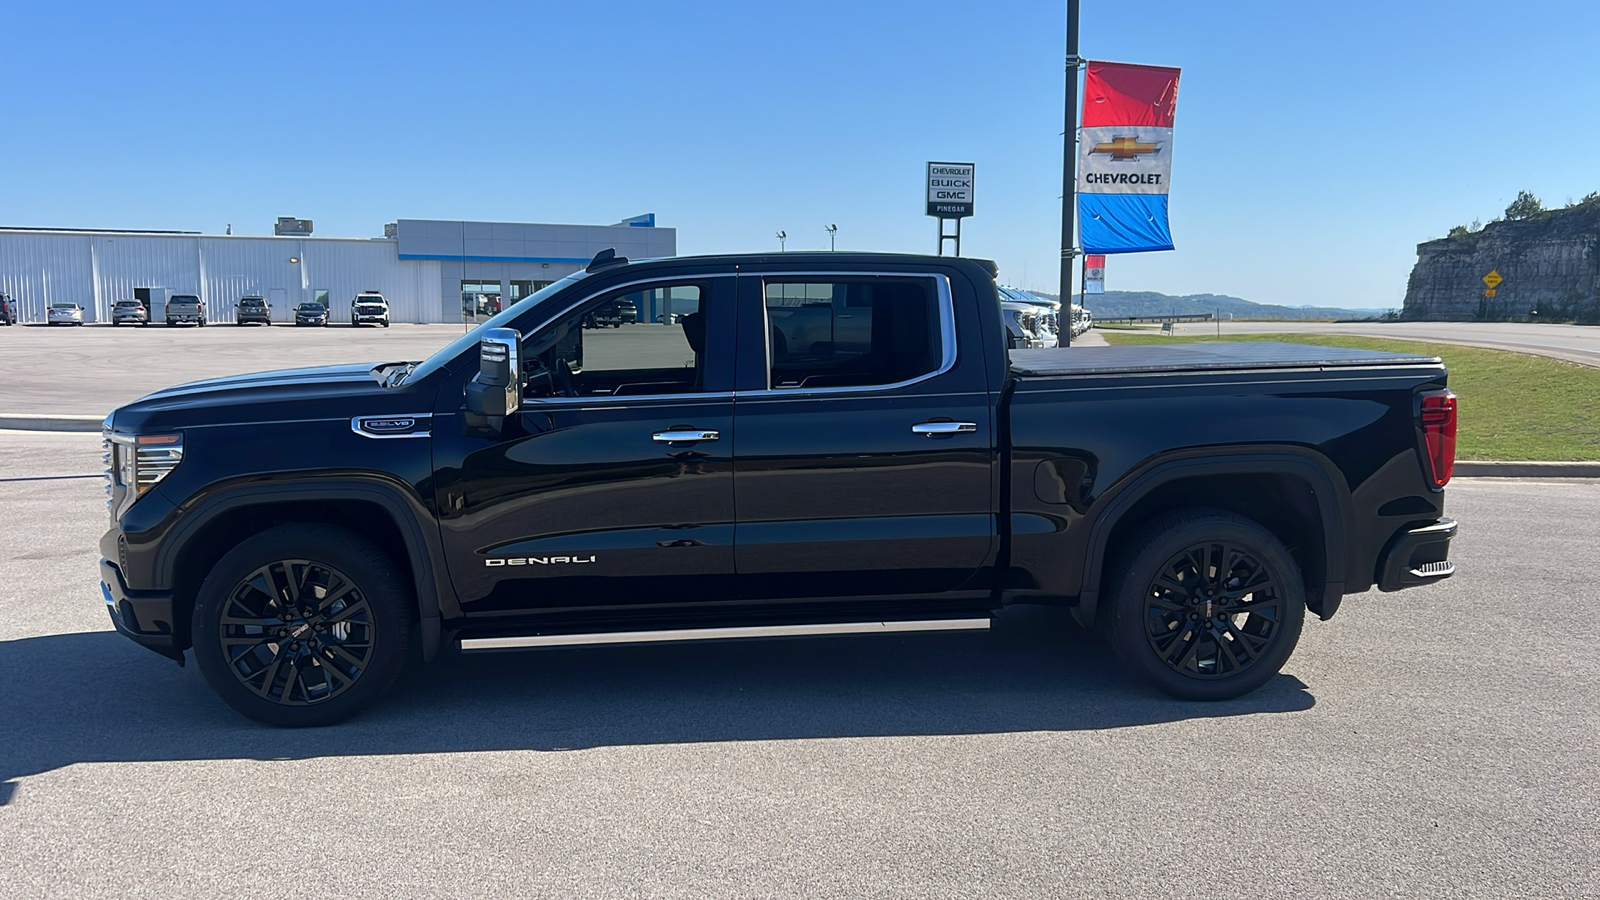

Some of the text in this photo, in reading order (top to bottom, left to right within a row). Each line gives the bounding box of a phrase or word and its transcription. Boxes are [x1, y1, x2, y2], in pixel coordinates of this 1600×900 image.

[932, 167, 971, 176] CHEVROLET
[931, 179, 970, 188] BUICK
[936, 191, 966, 199] GMC
[485, 554, 596, 567] DENALI
